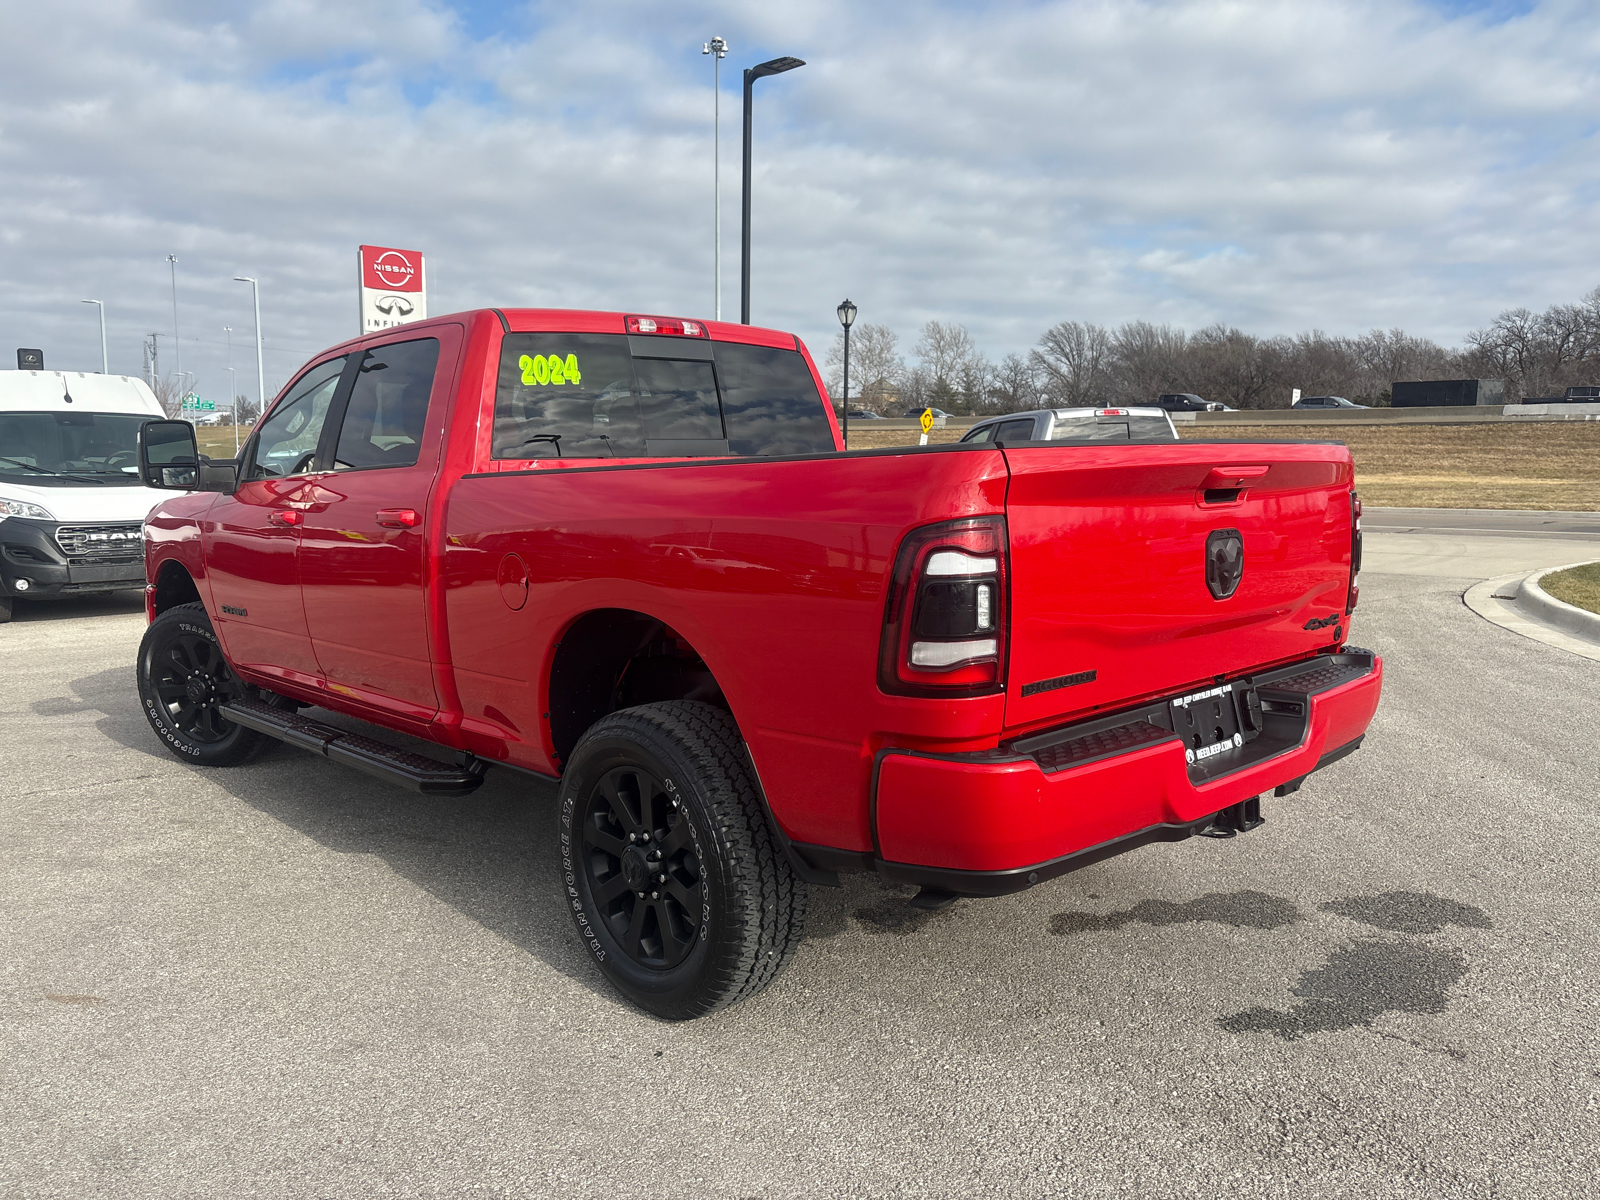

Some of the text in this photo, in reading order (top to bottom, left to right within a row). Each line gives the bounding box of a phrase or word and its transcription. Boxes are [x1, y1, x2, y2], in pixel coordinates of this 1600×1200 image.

[373, 263, 414, 274] NISSAN
[518, 353, 582, 386] 2024
[560, 833, 606, 962] TRANSFORCE
